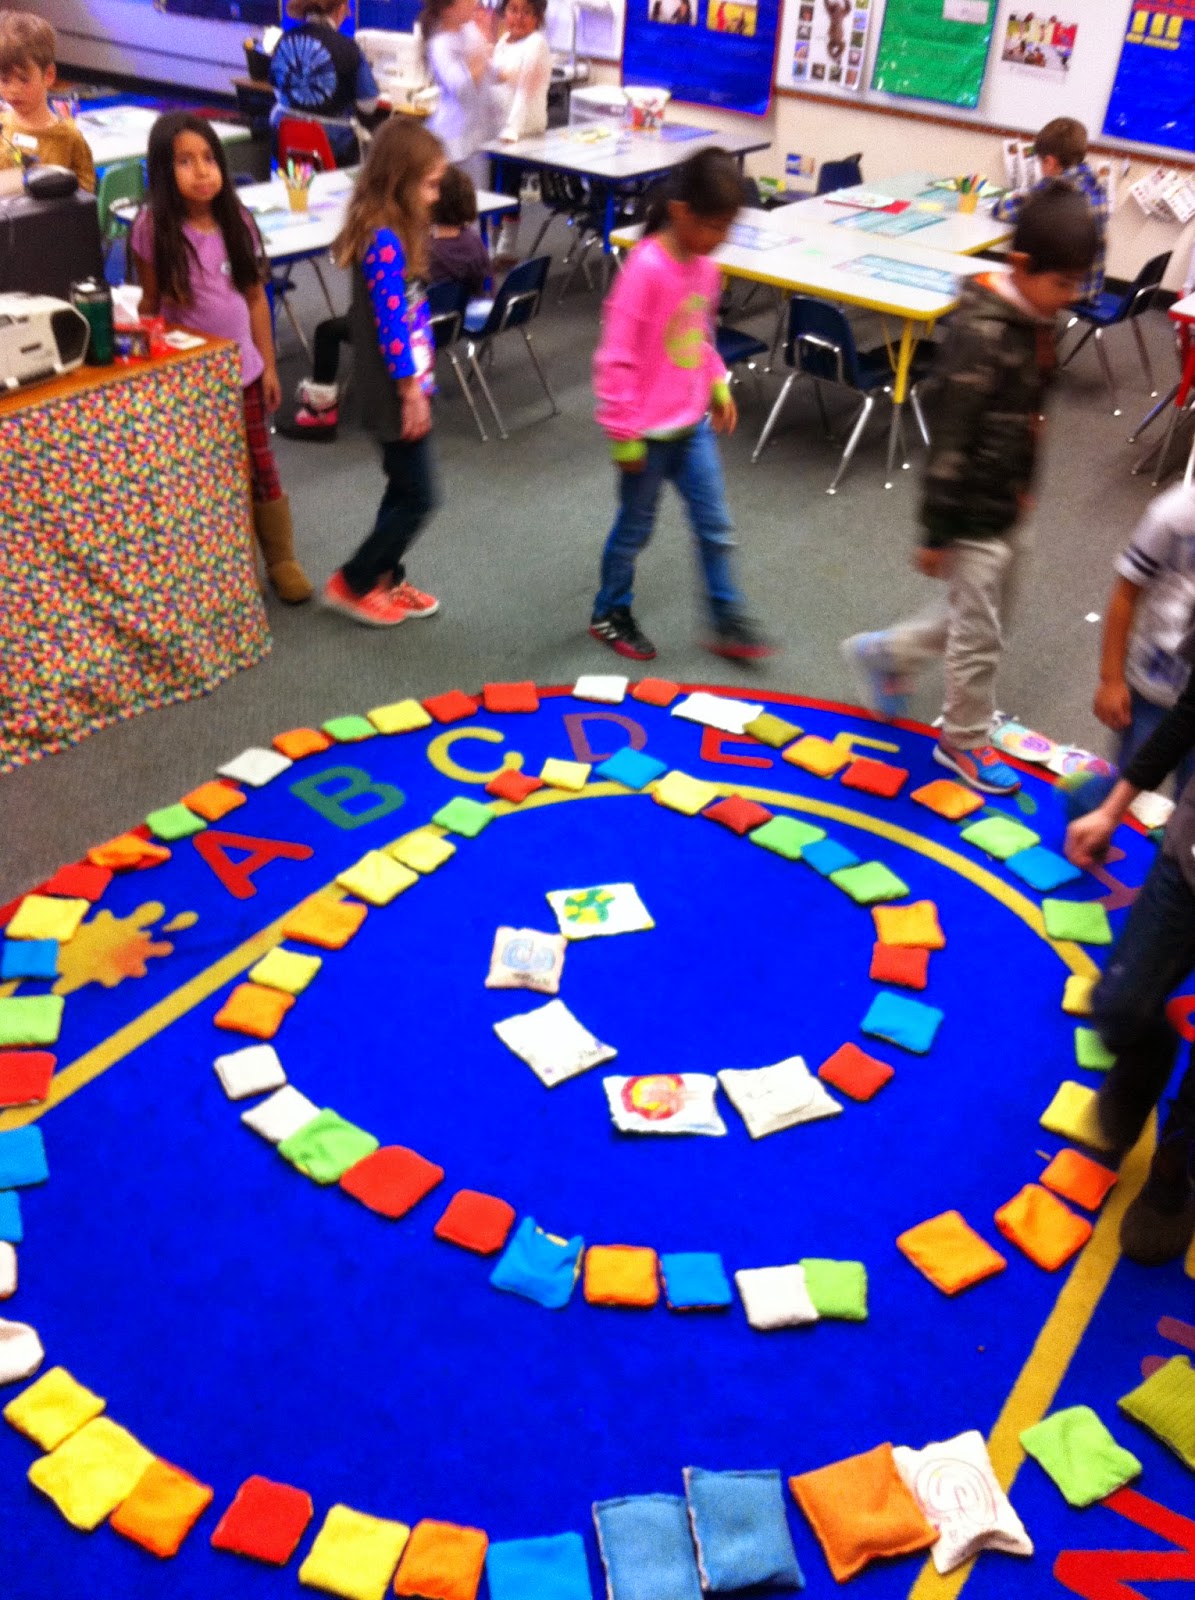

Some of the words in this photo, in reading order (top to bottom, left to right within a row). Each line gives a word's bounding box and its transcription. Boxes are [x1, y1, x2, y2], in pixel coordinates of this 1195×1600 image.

[193, 830, 314, 899] A
[289, 766, 406, 830] B
[427, 727, 524, 784] C
[563, 712, 648, 764] D
